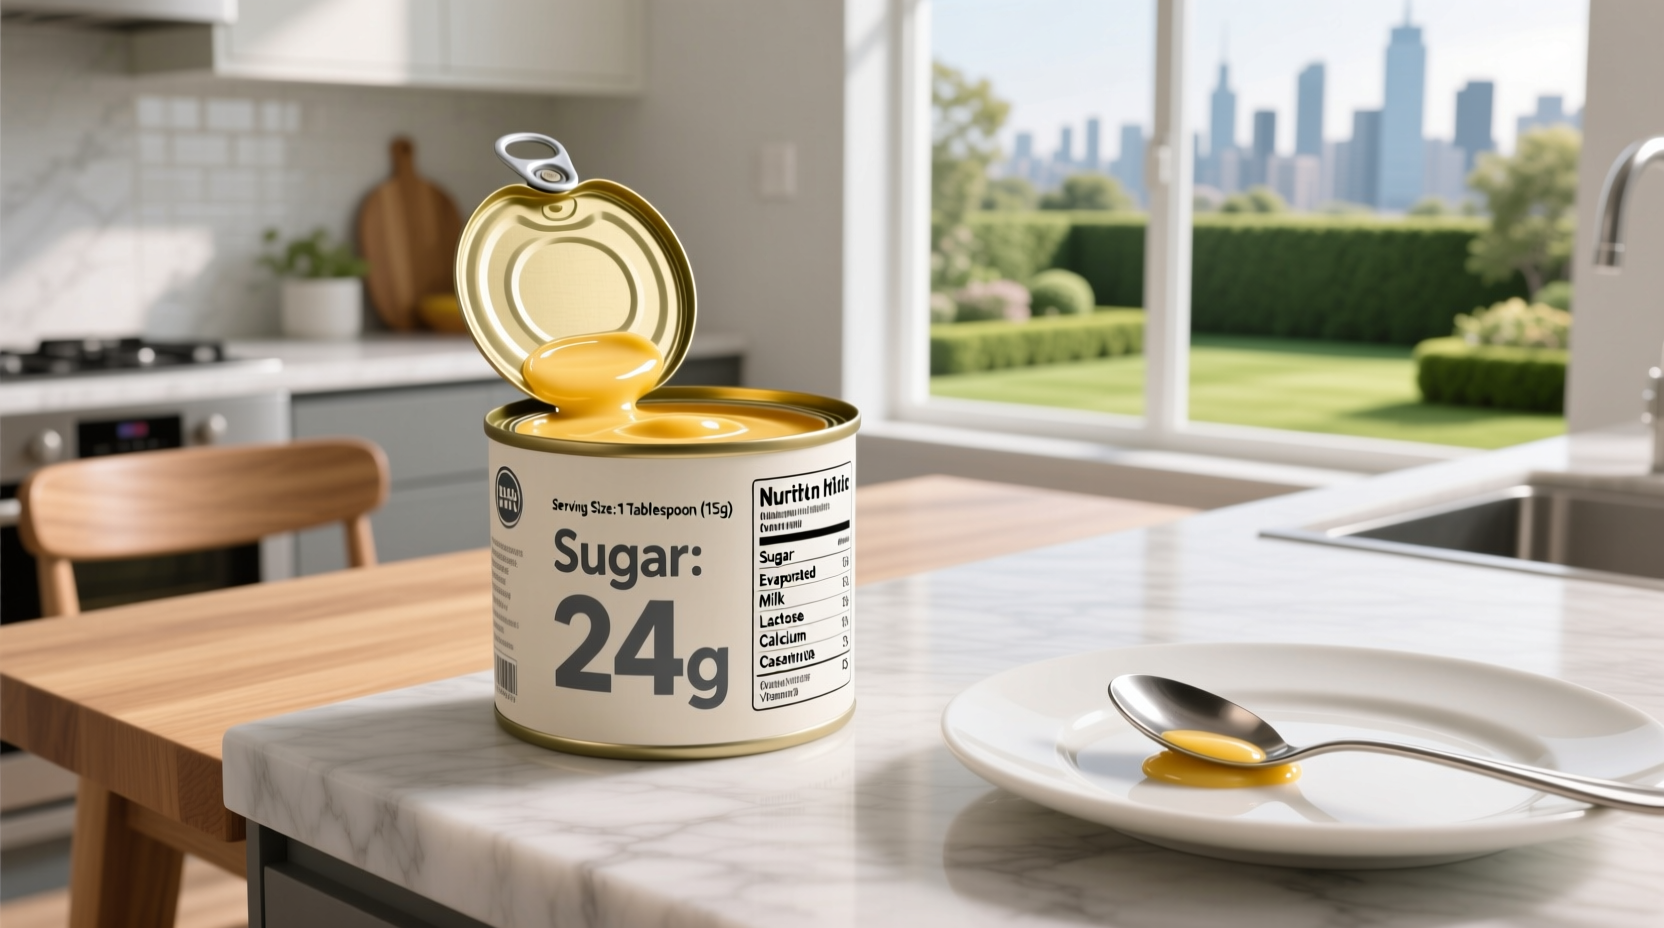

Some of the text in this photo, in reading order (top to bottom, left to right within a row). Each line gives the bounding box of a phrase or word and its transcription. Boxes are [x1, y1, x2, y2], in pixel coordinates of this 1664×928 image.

[625, 501, 697, 520] Tablespoon
[700, 500, 733, 519] (15g)
[554, 528, 702, 591] Sugar:
[759, 550, 795, 566] Sugar
[759, 591, 785, 608] Milk
[759, 612, 804, 628] Lactose
[759, 630, 807, 647] Calcium
[554, 594, 729, 710] 24g
